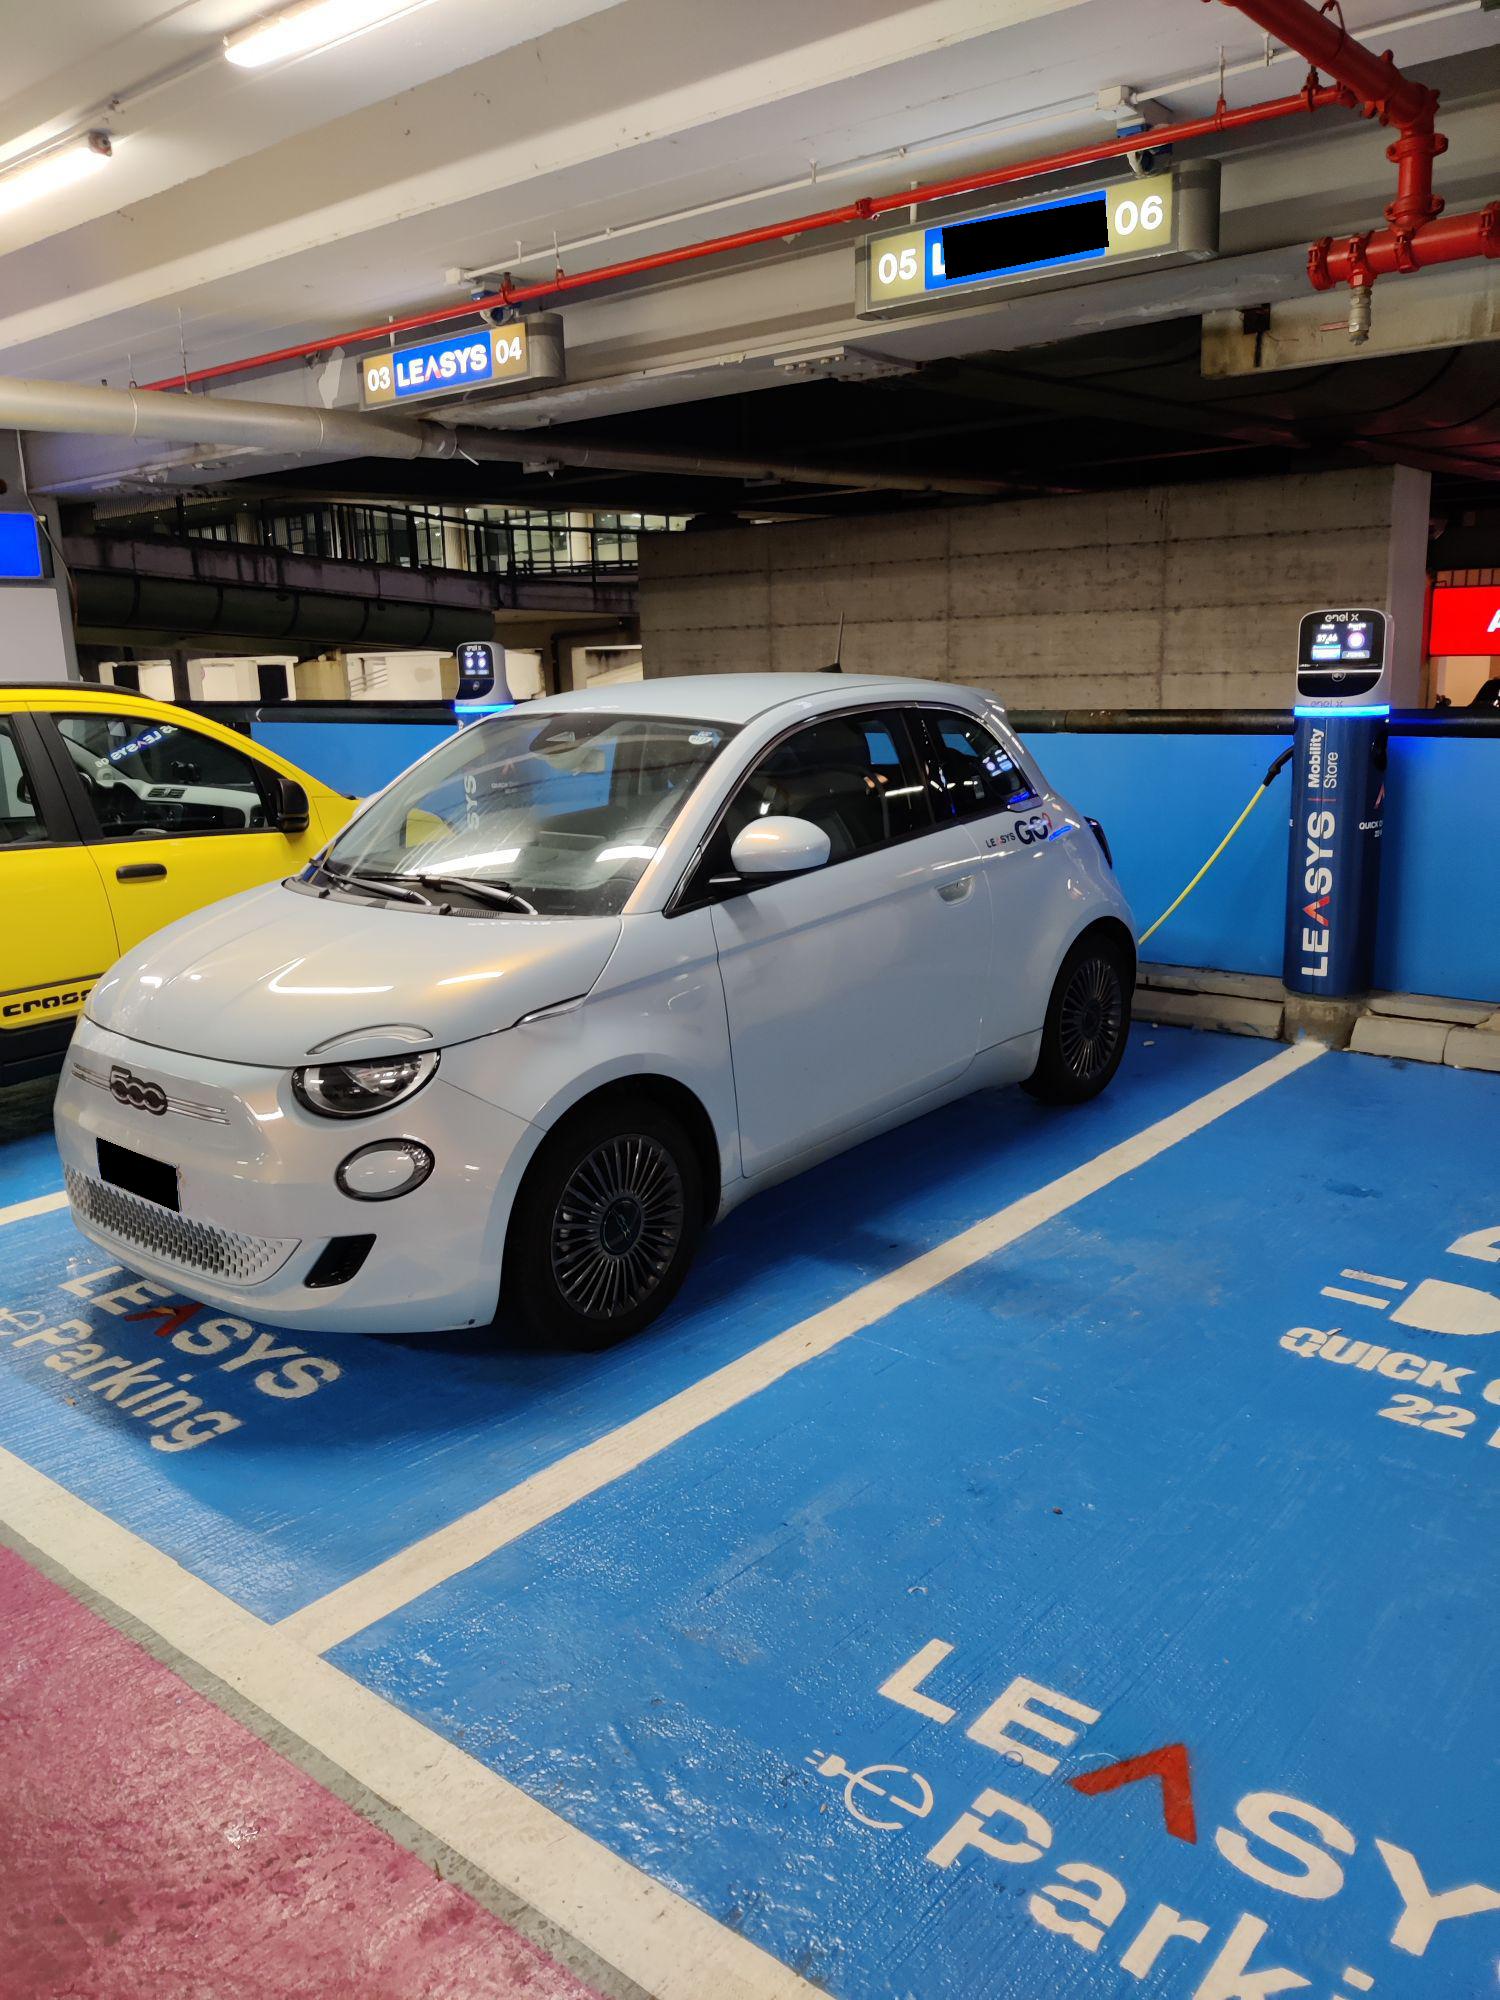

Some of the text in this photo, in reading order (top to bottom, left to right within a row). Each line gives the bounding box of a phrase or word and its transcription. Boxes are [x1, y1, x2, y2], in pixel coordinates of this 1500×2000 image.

[878, 248, 917, 285] 05
[1114, 195, 1163, 236] 06
[367, 336, 522, 392] 03 LEASYS 04
[1325, 612, 1348, 622] enel
[1307, 728, 1325, 789] Mobility
[1324, 751, 1339, 789] Store
[464, 775, 479, 830] SYS
[985, 832, 1016, 848] LEASYS
[1301, 810, 1336, 978] LEASYS
[110, 1065, 168, 1116] 500
[59, 1265, 344, 1399] LEASYS
[1279, 1327, 1477, 1395] QUICK
[12, 1318, 247, 1452] Parking
[1377, 1394, 1477, 1438] 22
[878, 1638, 1500, 1983] LEASY
[926, 1787, 1376, 2000] Park
